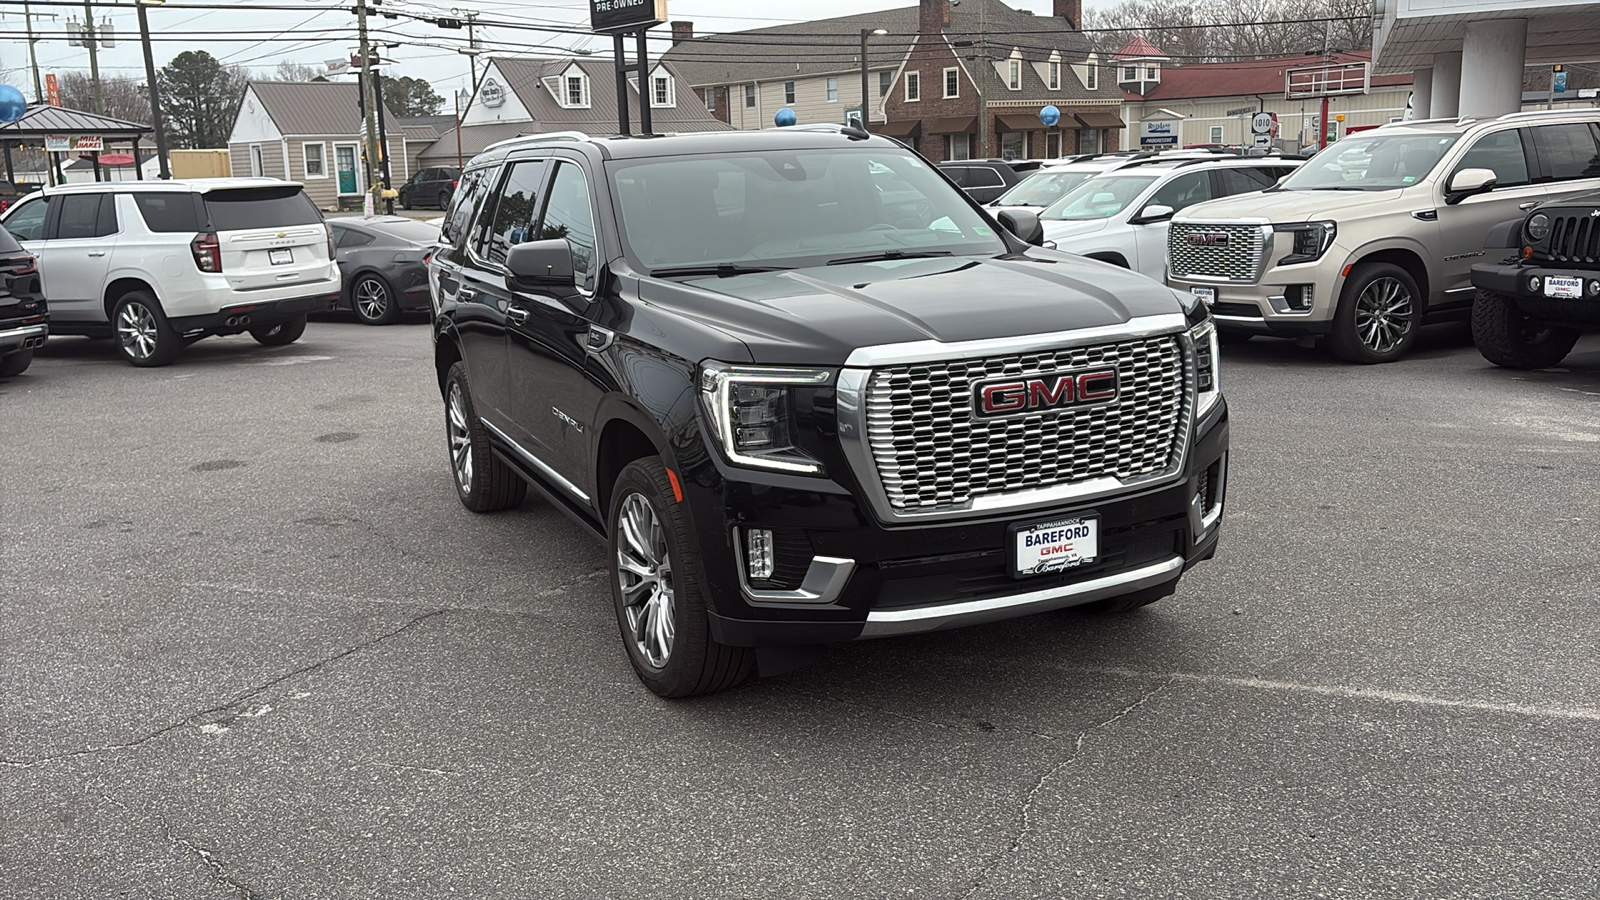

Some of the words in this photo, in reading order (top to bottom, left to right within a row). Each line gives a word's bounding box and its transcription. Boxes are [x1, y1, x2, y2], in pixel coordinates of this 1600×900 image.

[1255, 118, 1270, 127] 1010
[1187, 233, 1227, 246] GMC
[982, 370, 1115, 413] GMC
[552, 406, 584, 434] DENALI
[1036, 518, 1080, 530] TAPPAHANNOCK
[1025, 525, 1090, 548] BAREFORD
[1040, 543, 1074, 556] GMC
